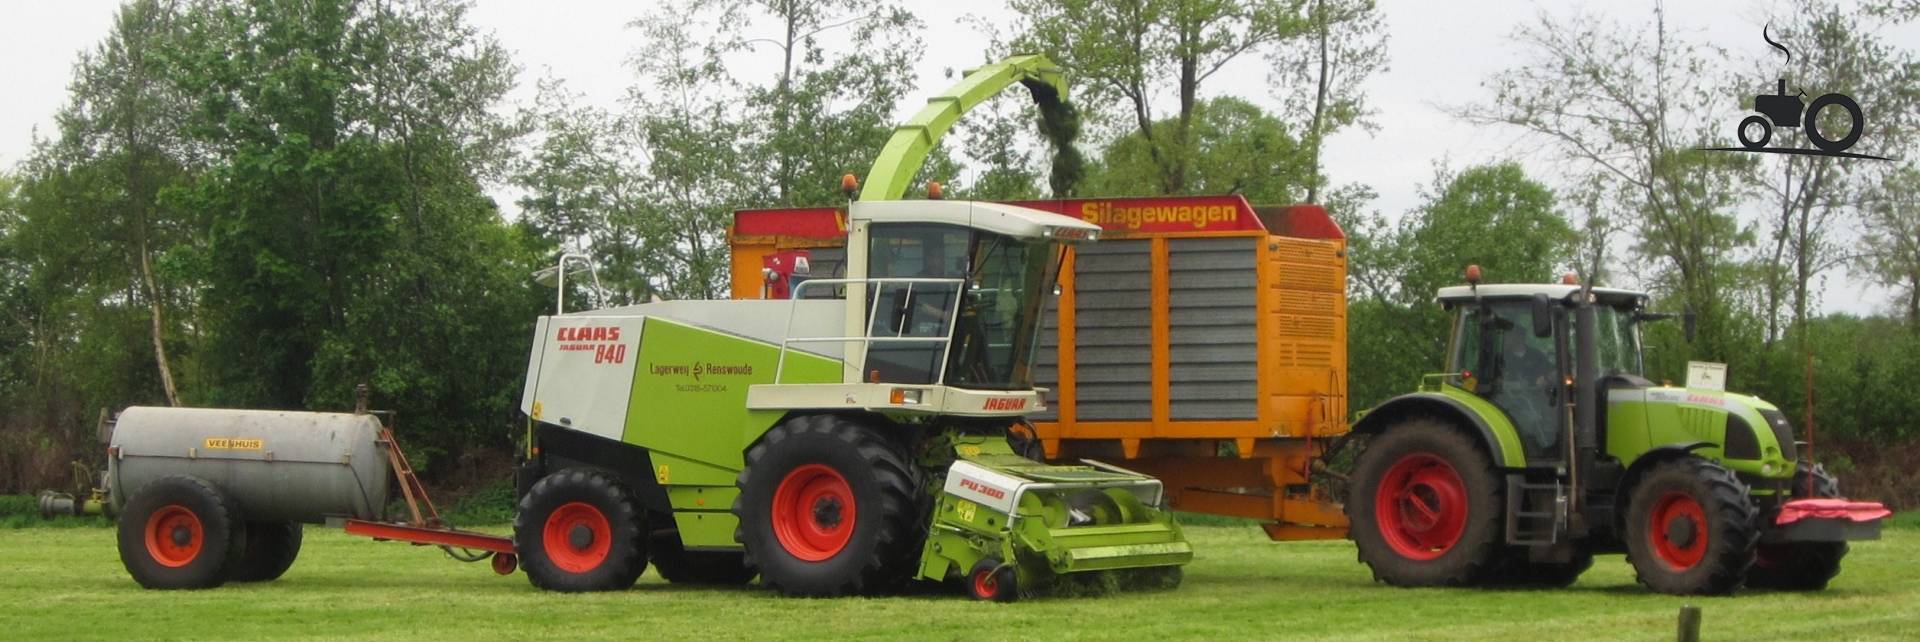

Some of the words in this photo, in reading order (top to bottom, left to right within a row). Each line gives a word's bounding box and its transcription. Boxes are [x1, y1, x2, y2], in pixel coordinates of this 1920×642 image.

[1081, 202, 1237, 228] Silagewagen
[557, 327, 620, 341] CLAAS
[594, 344, 626, 364] 840
[706, 363, 753, 376] Renswoude
[983, 398, 1026, 410] JAGUAR
